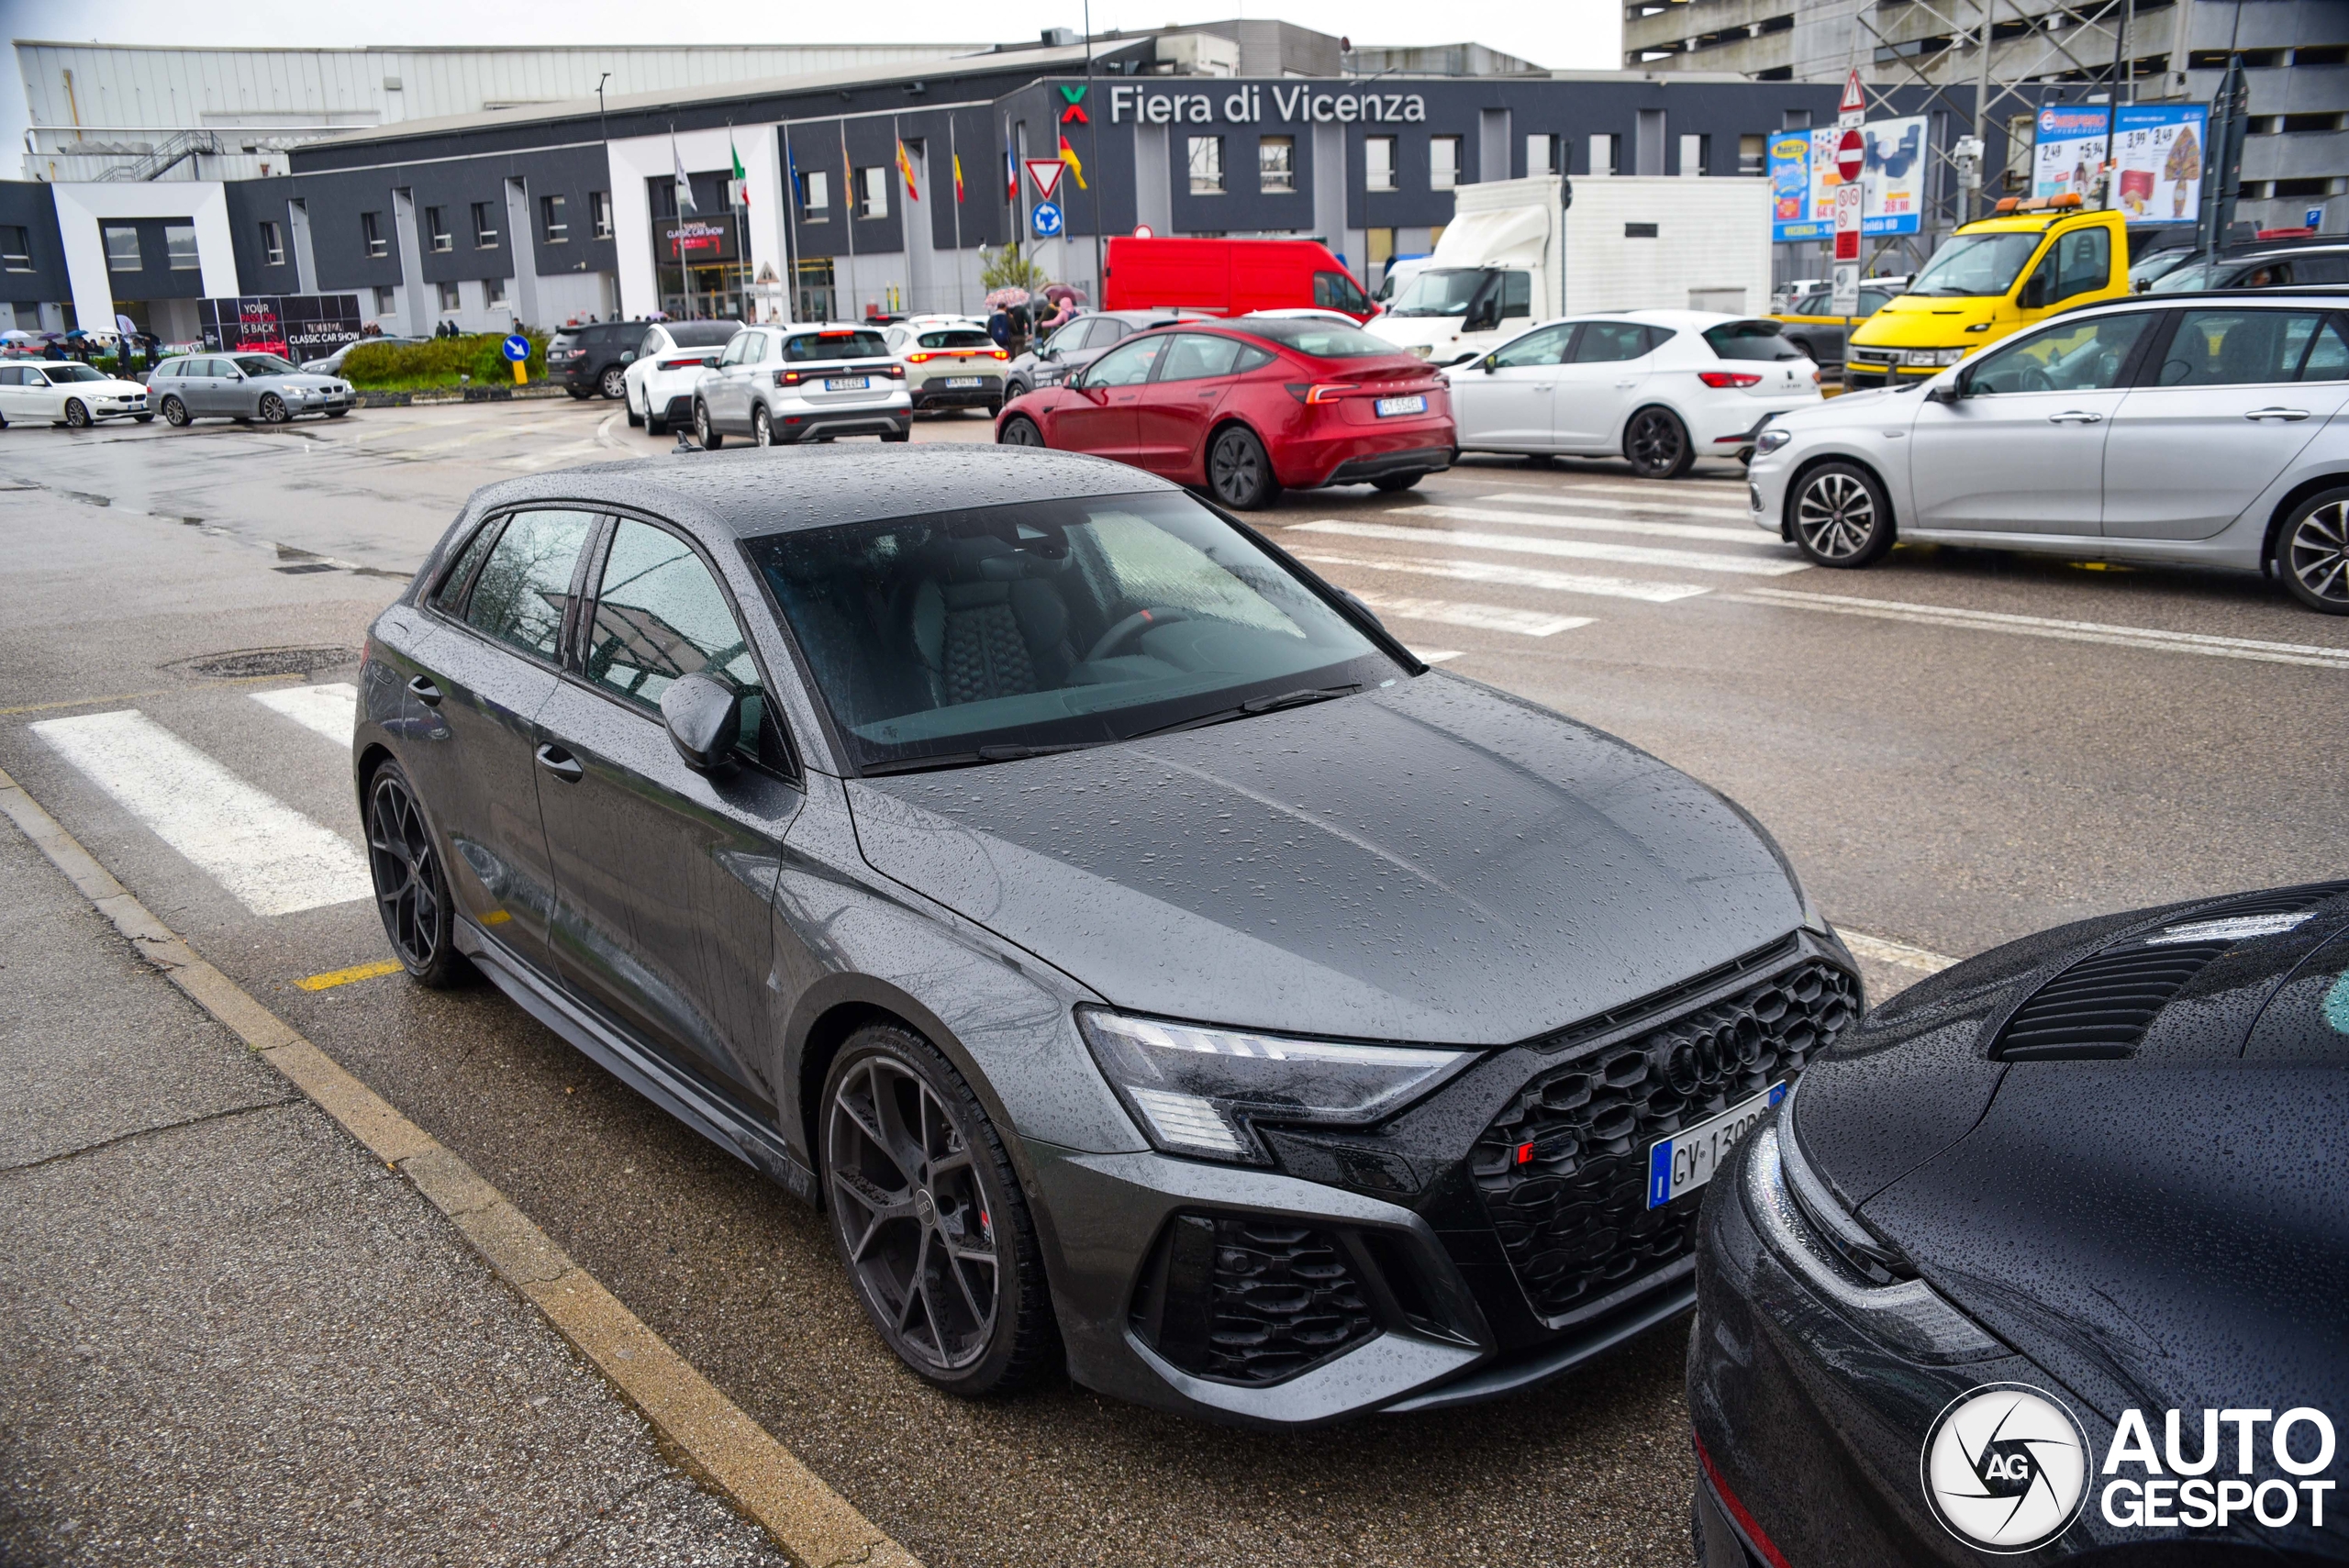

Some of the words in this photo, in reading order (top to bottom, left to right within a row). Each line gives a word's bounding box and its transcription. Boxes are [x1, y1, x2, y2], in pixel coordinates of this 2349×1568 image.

[1110, 84, 1213, 124] Fiera
[1224, 84, 1261, 122] di
[1272, 84, 1426, 122] Vicenza
[2310, 212, 2318, 221] P
[243, 304, 269, 314] YOUR
[240, 313, 276, 323] PASSON
[250, 323, 274, 334] BACK
[289, 334, 321, 344] CLASSIC
[321, 332, 338, 342] CAR
[337, 331, 360, 341] SHOW
[1673, 1139, 1700, 1186] GV
